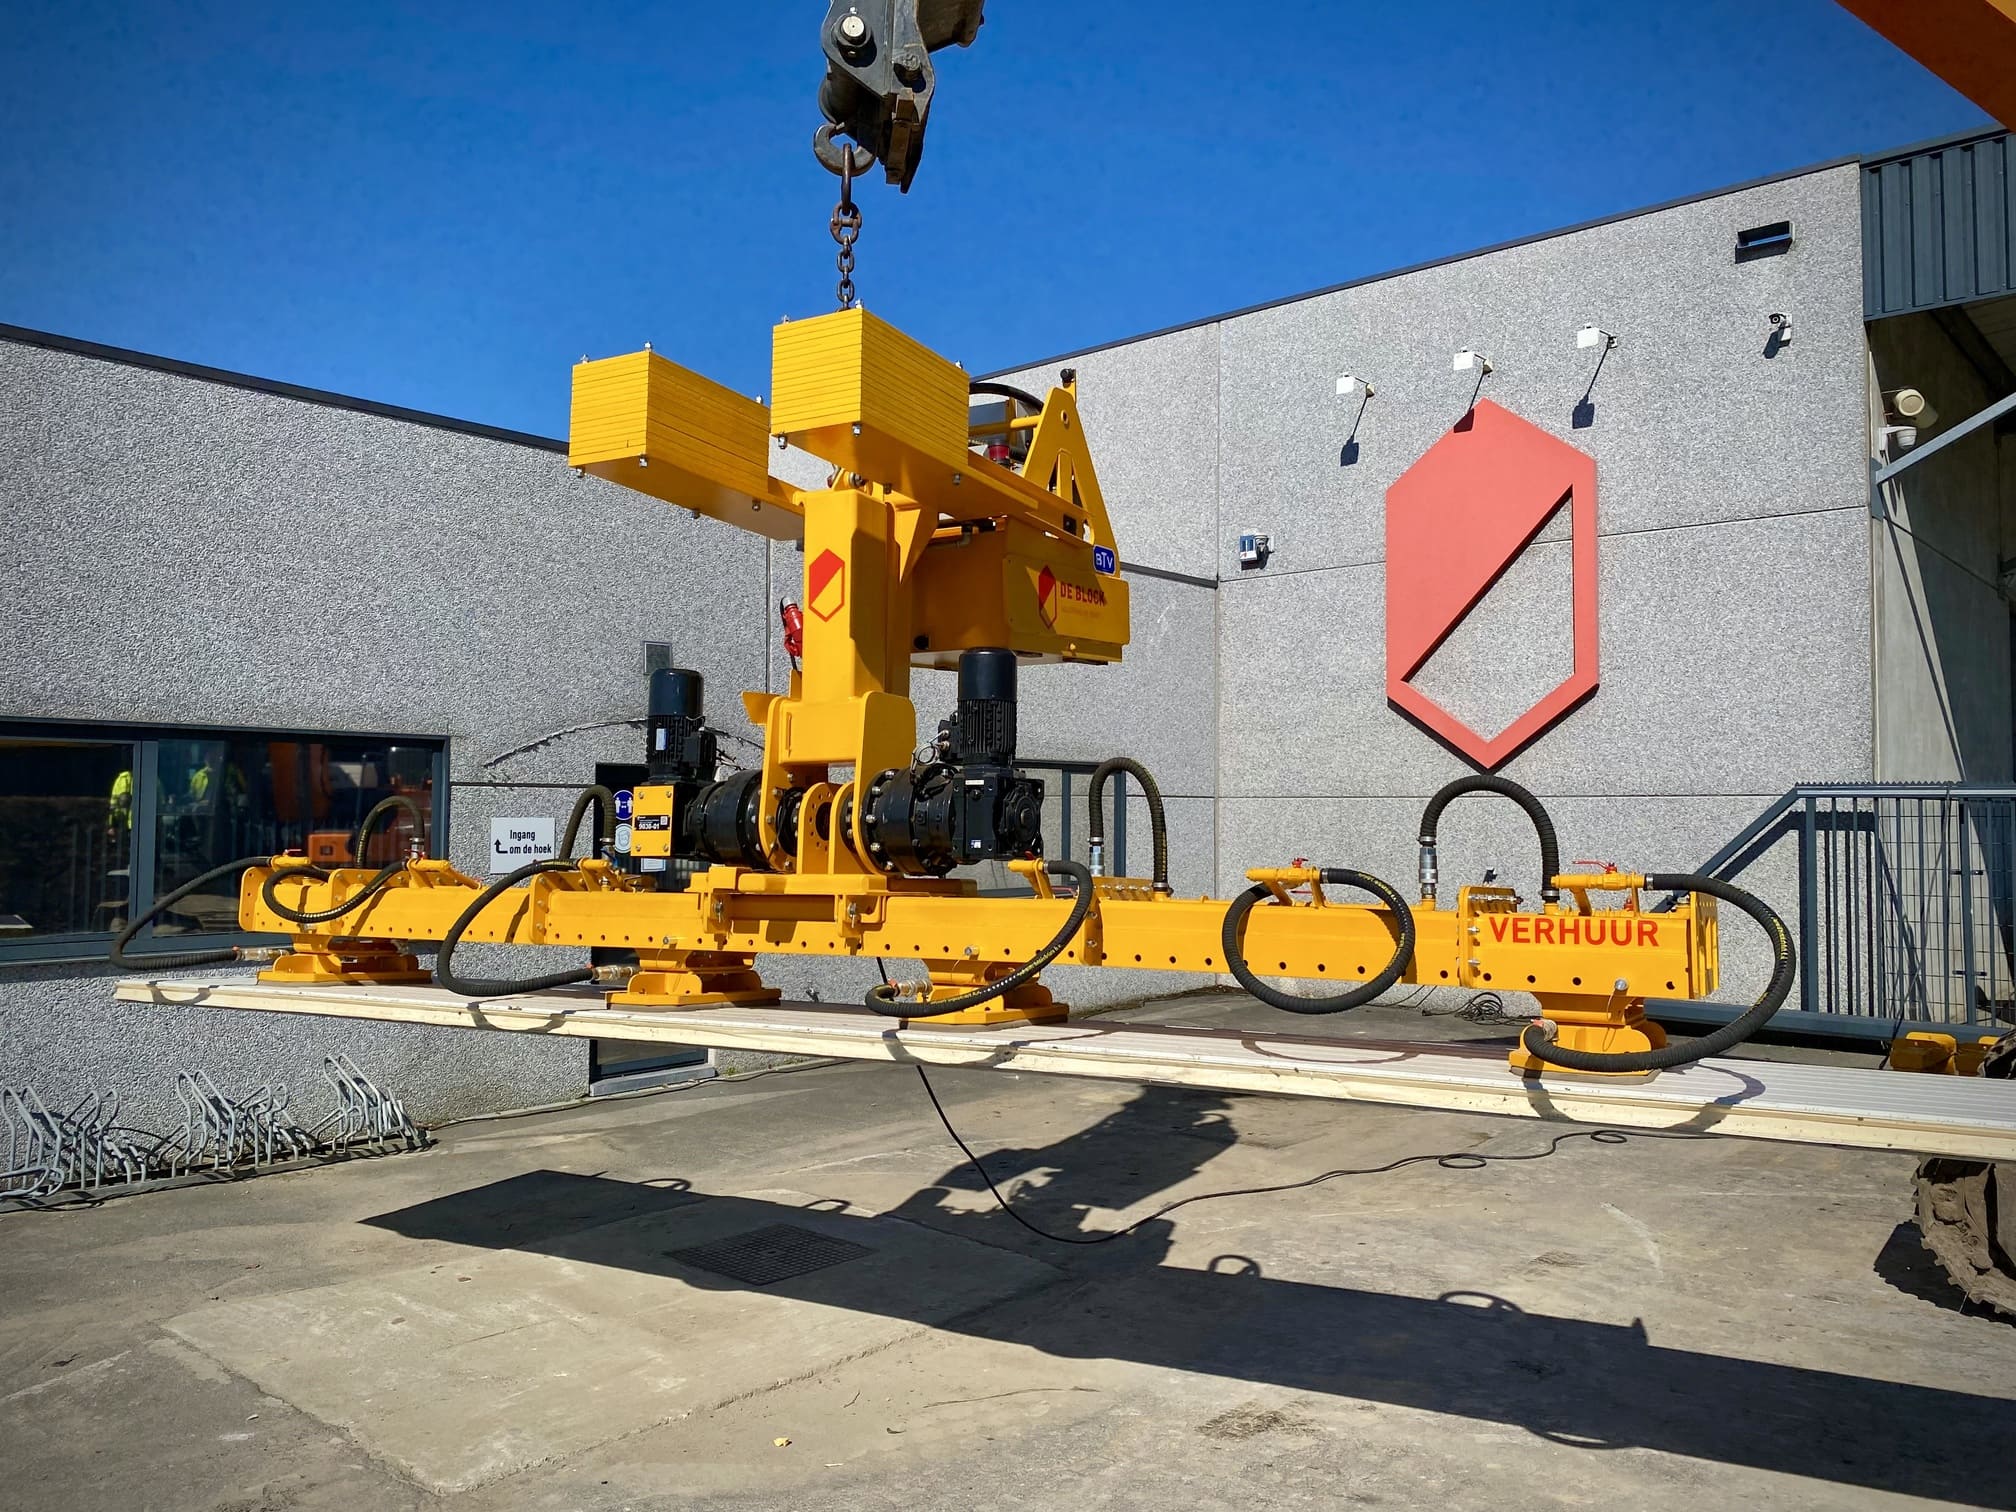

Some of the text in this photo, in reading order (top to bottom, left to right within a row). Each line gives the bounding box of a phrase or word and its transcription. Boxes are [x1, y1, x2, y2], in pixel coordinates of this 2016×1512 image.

[1095, 551, 1113, 569] BTV
[1060, 581, 1106, 606] DE BLOCK
[509, 829, 536, 842] Ingang
[509, 843, 552, 854] om de hoek
[1489, 917, 1660, 947] VERHUUR
